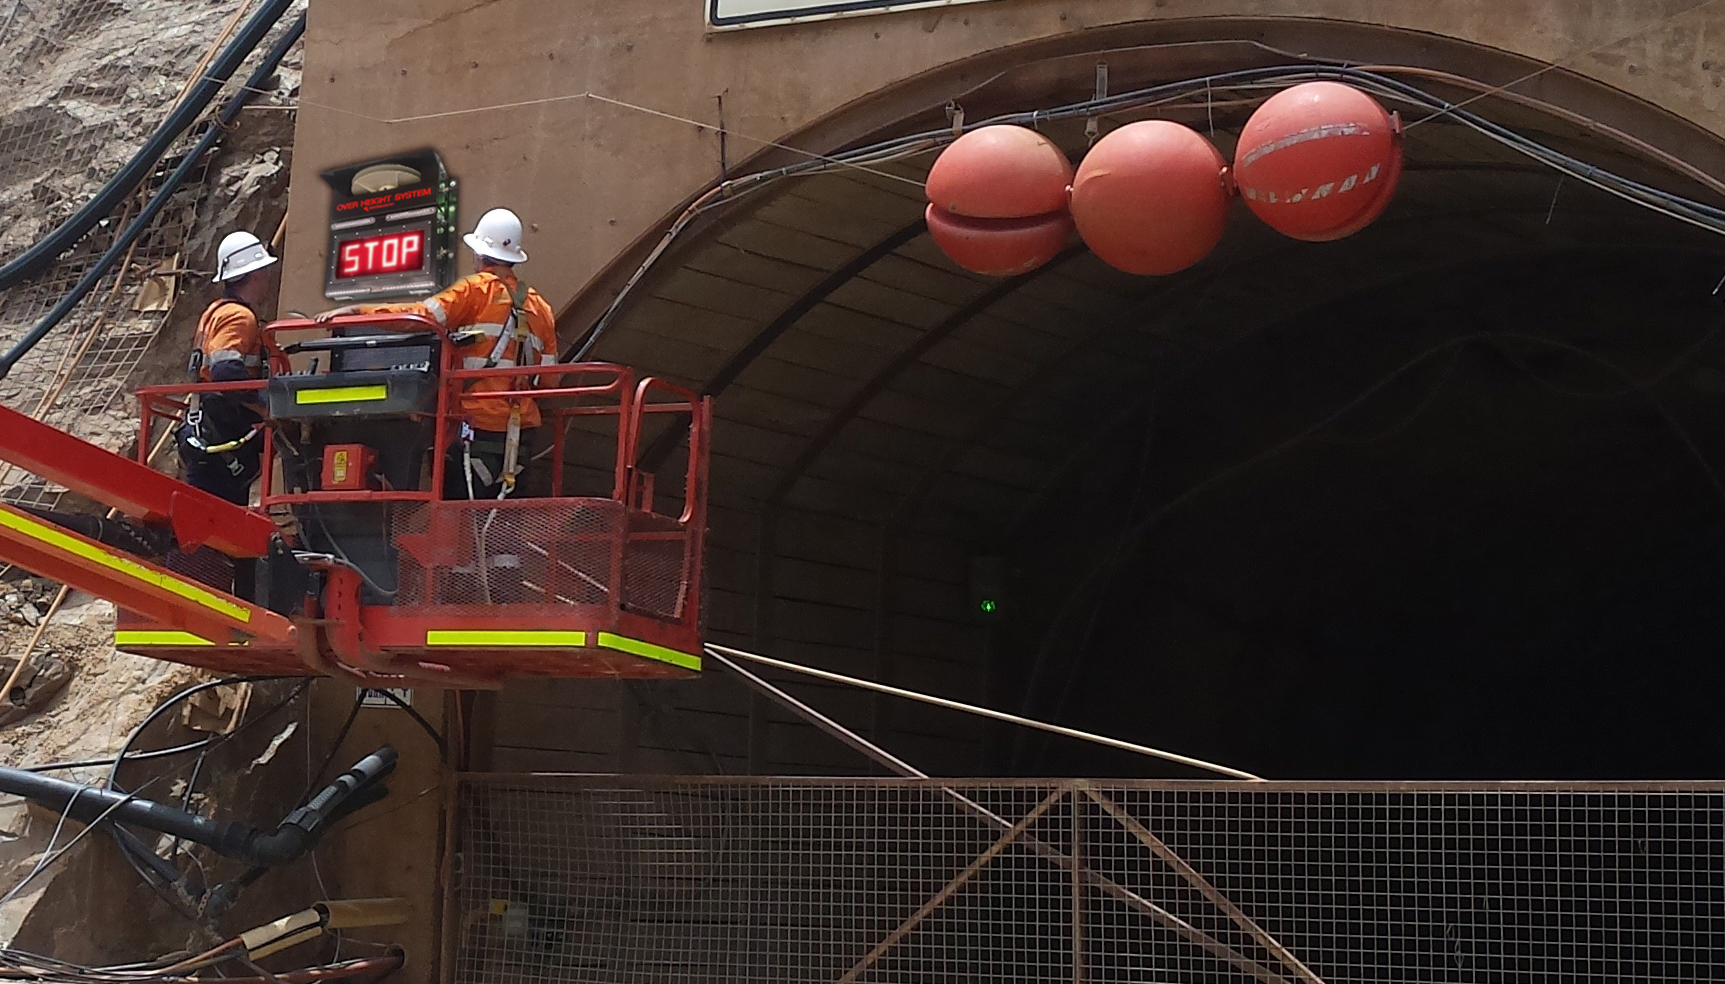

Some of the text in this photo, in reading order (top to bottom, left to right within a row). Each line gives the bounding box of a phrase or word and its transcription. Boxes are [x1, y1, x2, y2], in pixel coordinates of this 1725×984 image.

[336, 201, 359, 212] OVER
[360, 194, 392, 207] HEIGHT
[394, 187, 432, 201] SYSTEM
[343, 235, 420, 273] STOP
